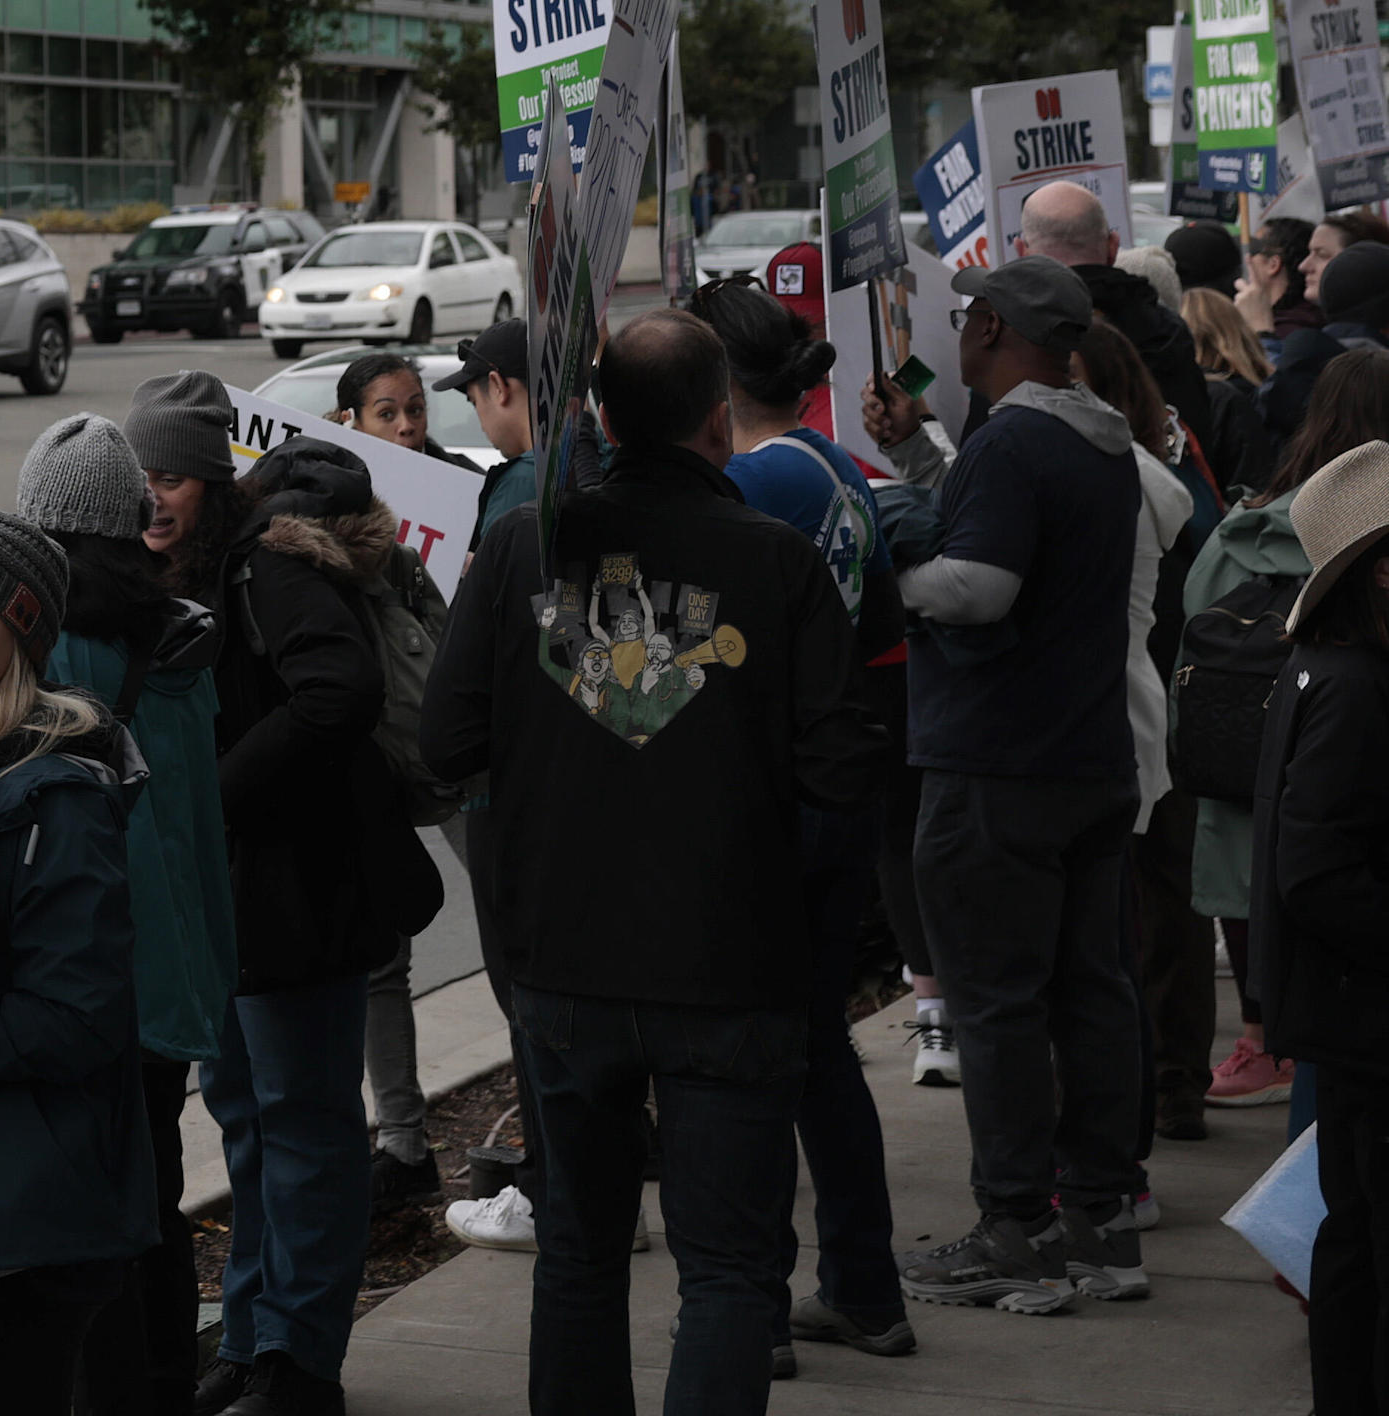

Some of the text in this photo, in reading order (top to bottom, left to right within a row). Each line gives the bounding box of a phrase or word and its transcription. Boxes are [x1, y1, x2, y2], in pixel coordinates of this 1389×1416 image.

[1311, 8, 1362, 50] STRIKE
[1207, 43, 1230, 79] FOR
[518, 76, 600, 121] Our Pfession
[831, 43, 887, 144] STRIKE
[1035, 87, 1062, 121] ON
[1196, 81, 1274, 132] PATIENTS
[1014, 121, 1094, 171] STRIKE
[602, 566, 635, 586] 3299
[688, 593, 710, 607] ONE
[688, 606, 708, 621] DAY
